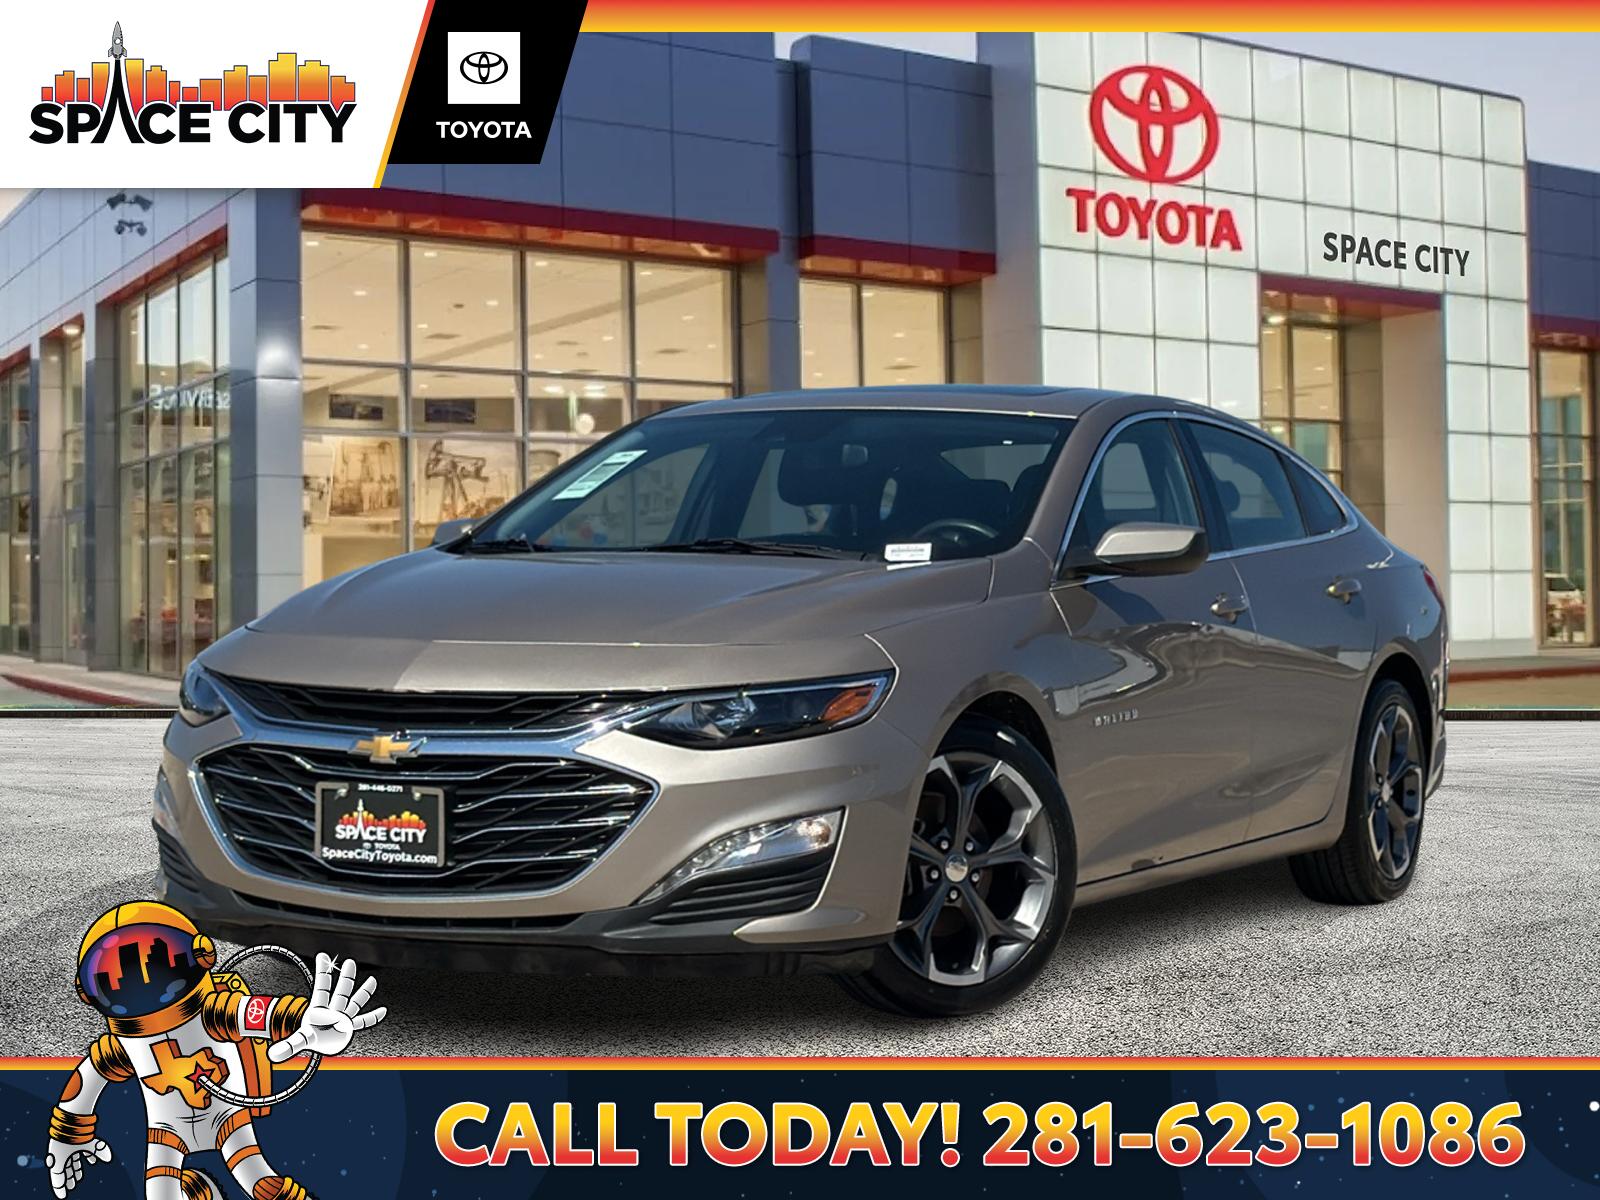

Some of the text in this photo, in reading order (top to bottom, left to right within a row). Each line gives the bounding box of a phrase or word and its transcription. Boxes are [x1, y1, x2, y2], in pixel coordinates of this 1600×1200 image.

[1066, 187, 1242, 251] TOYOTA
[1322, 231, 1471, 277] SPACE CITY
[335, 813, 427, 843] SPACE CITY
[322, 847, 438, 864] SpaceCityToyota.com
[374, 842, 400, 850] TOYOTA
